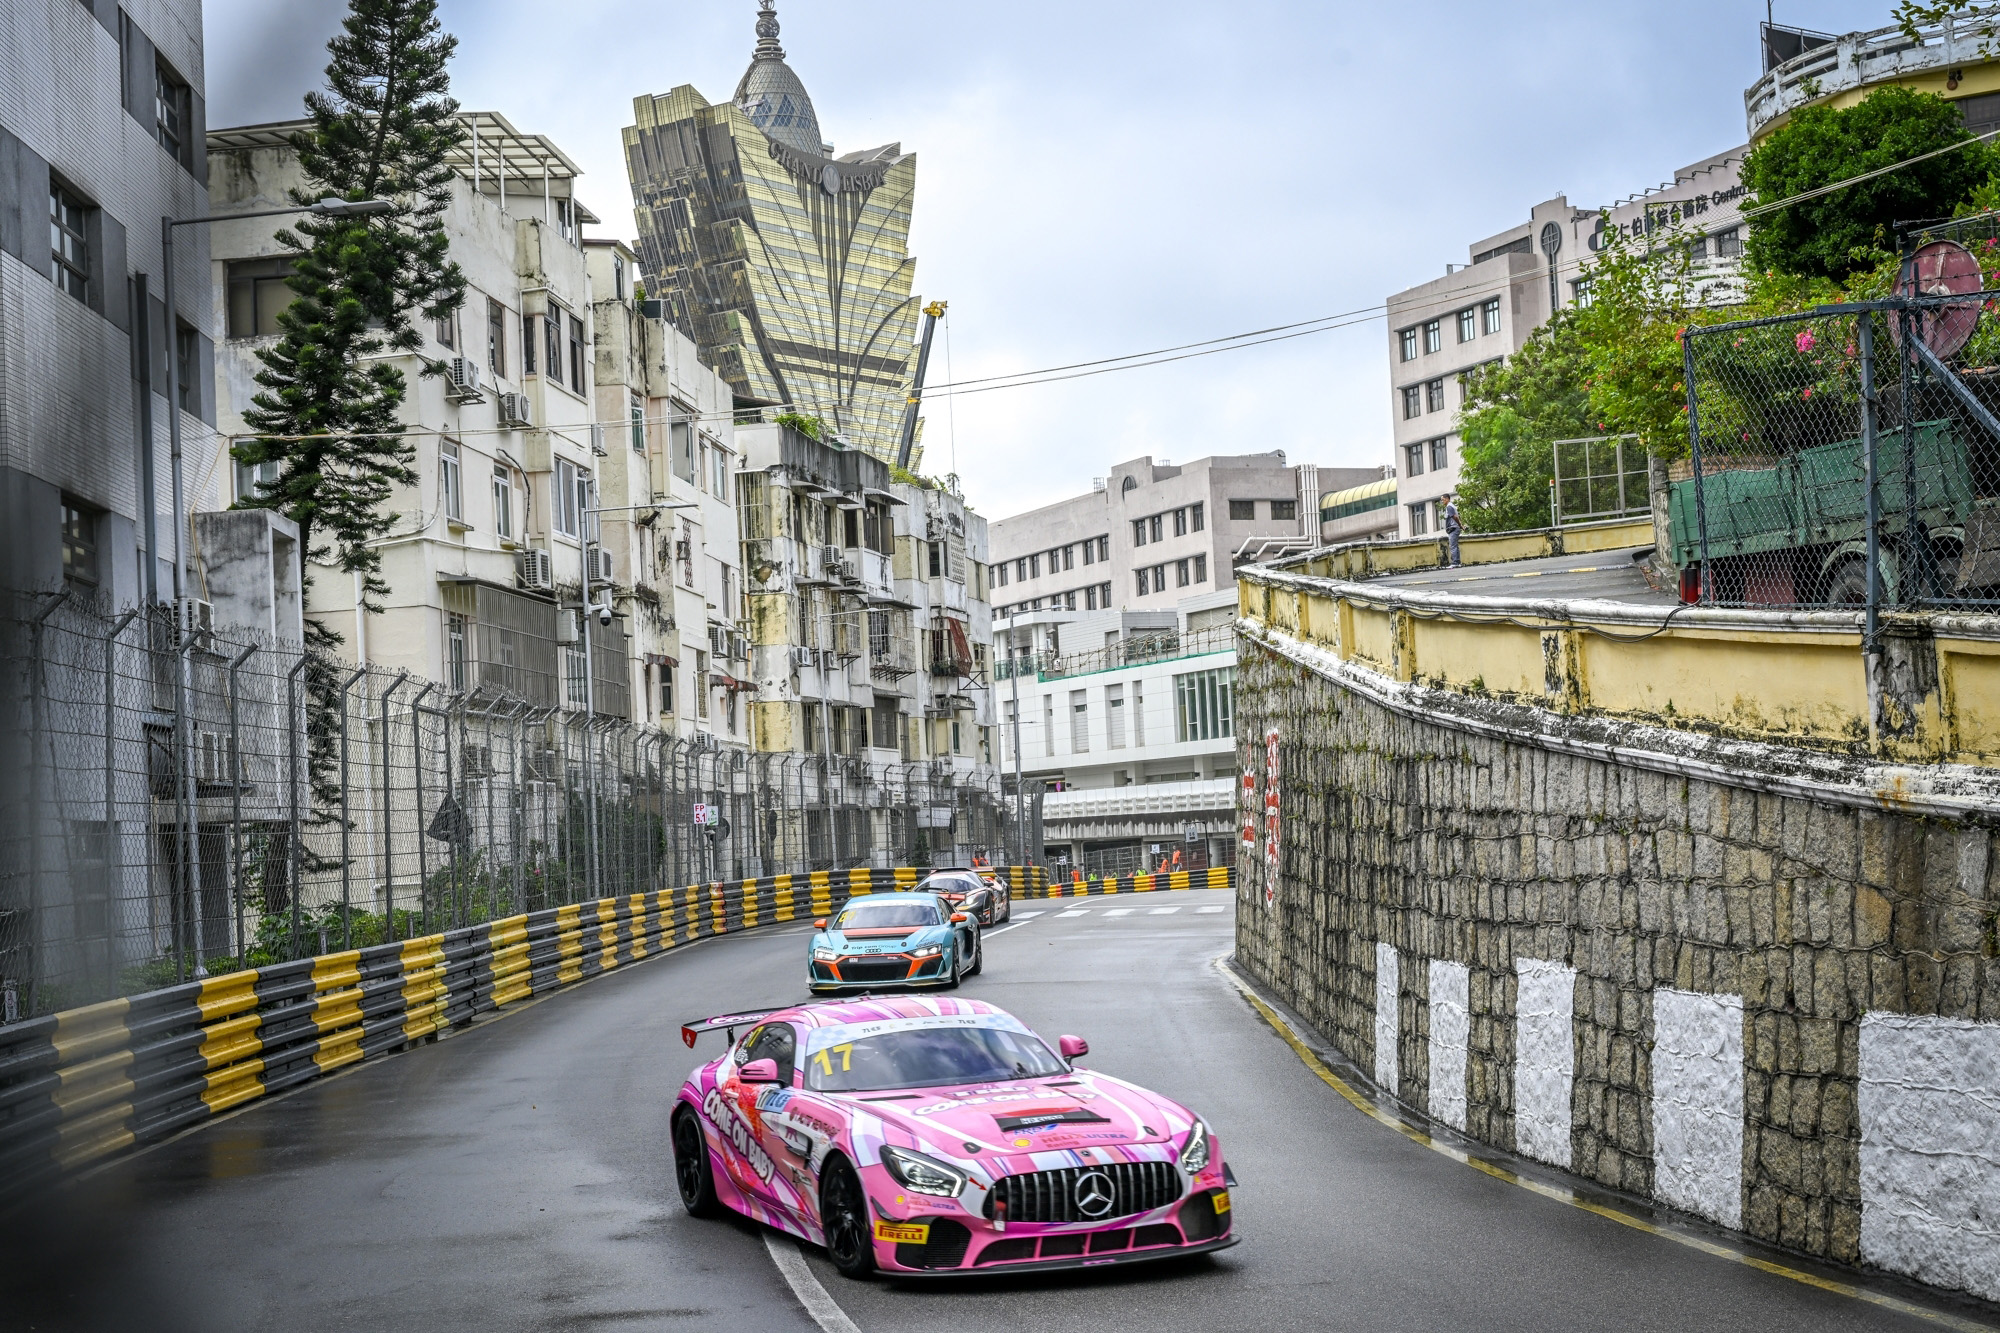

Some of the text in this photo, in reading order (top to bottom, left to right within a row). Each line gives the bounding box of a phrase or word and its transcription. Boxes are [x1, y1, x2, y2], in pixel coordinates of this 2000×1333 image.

[769, 142, 822, 185] GRAND
[696, 813, 706, 822] 5.1
[813, 1043, 853, 1076] 17
[703, 1087, 775, 1186] COME ON BABY
[1042, 1134, 1085, 1144] HELIX
[880, 1224, 923, 1240] PIRELLI
